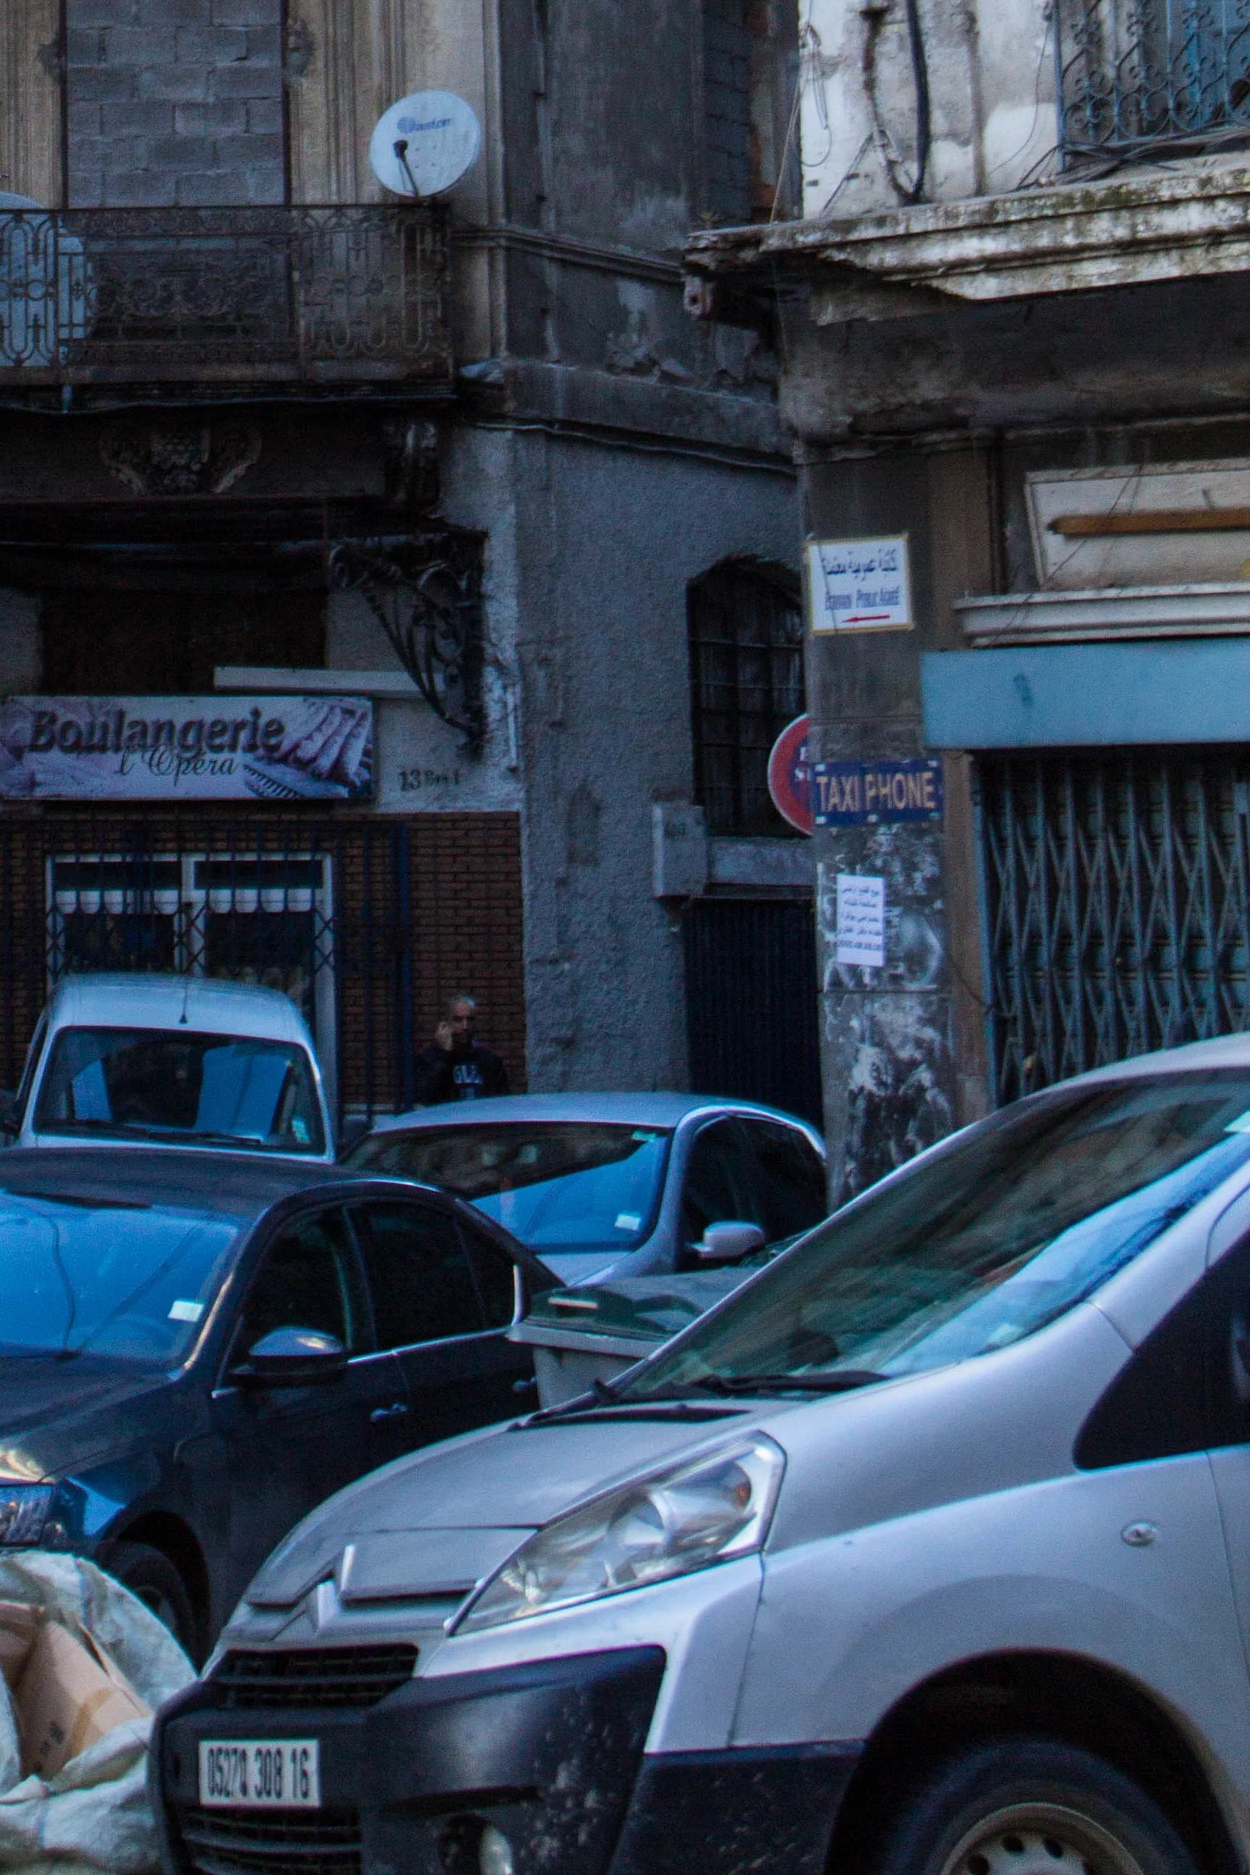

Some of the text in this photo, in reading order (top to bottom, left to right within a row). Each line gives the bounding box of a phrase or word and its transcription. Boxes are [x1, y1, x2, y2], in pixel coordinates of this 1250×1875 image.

[27, 705, 286, 759] Boulangerie
[816, 771, 936, 812] TAXI PHONE
[254, 1746, 282, 1799] 308
[291, 1746, 309, 1799] 16
